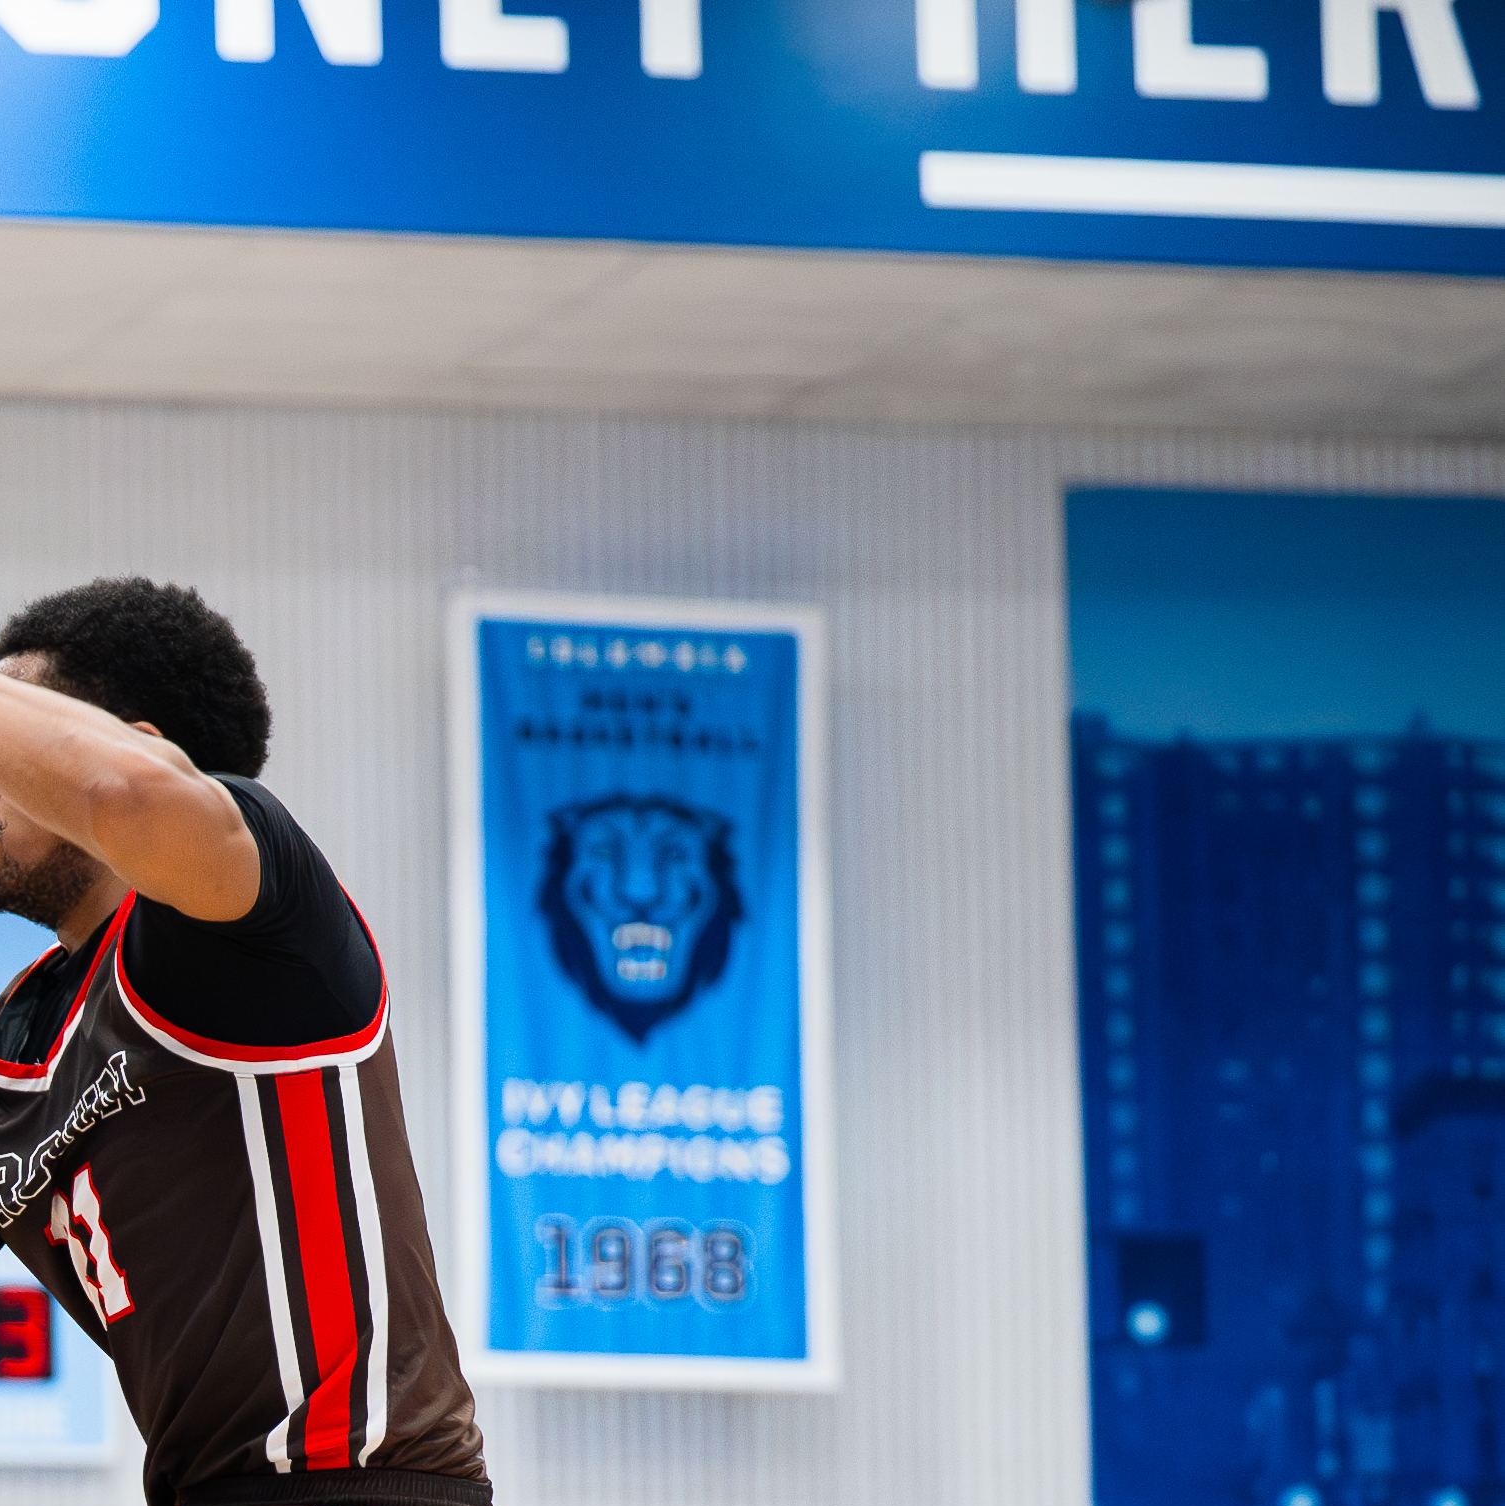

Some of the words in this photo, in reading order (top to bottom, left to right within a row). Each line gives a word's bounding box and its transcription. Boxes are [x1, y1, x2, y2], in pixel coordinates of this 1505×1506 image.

[501, 1077, 586, 1128] IVY
[589, 1081, 784, 1133] LEAGUE
[496, 1127, 789, 1185] CHAMPIONS
[45, 1161, 135, 1331] 11
[538, 1217, 752, 1307] 1968
